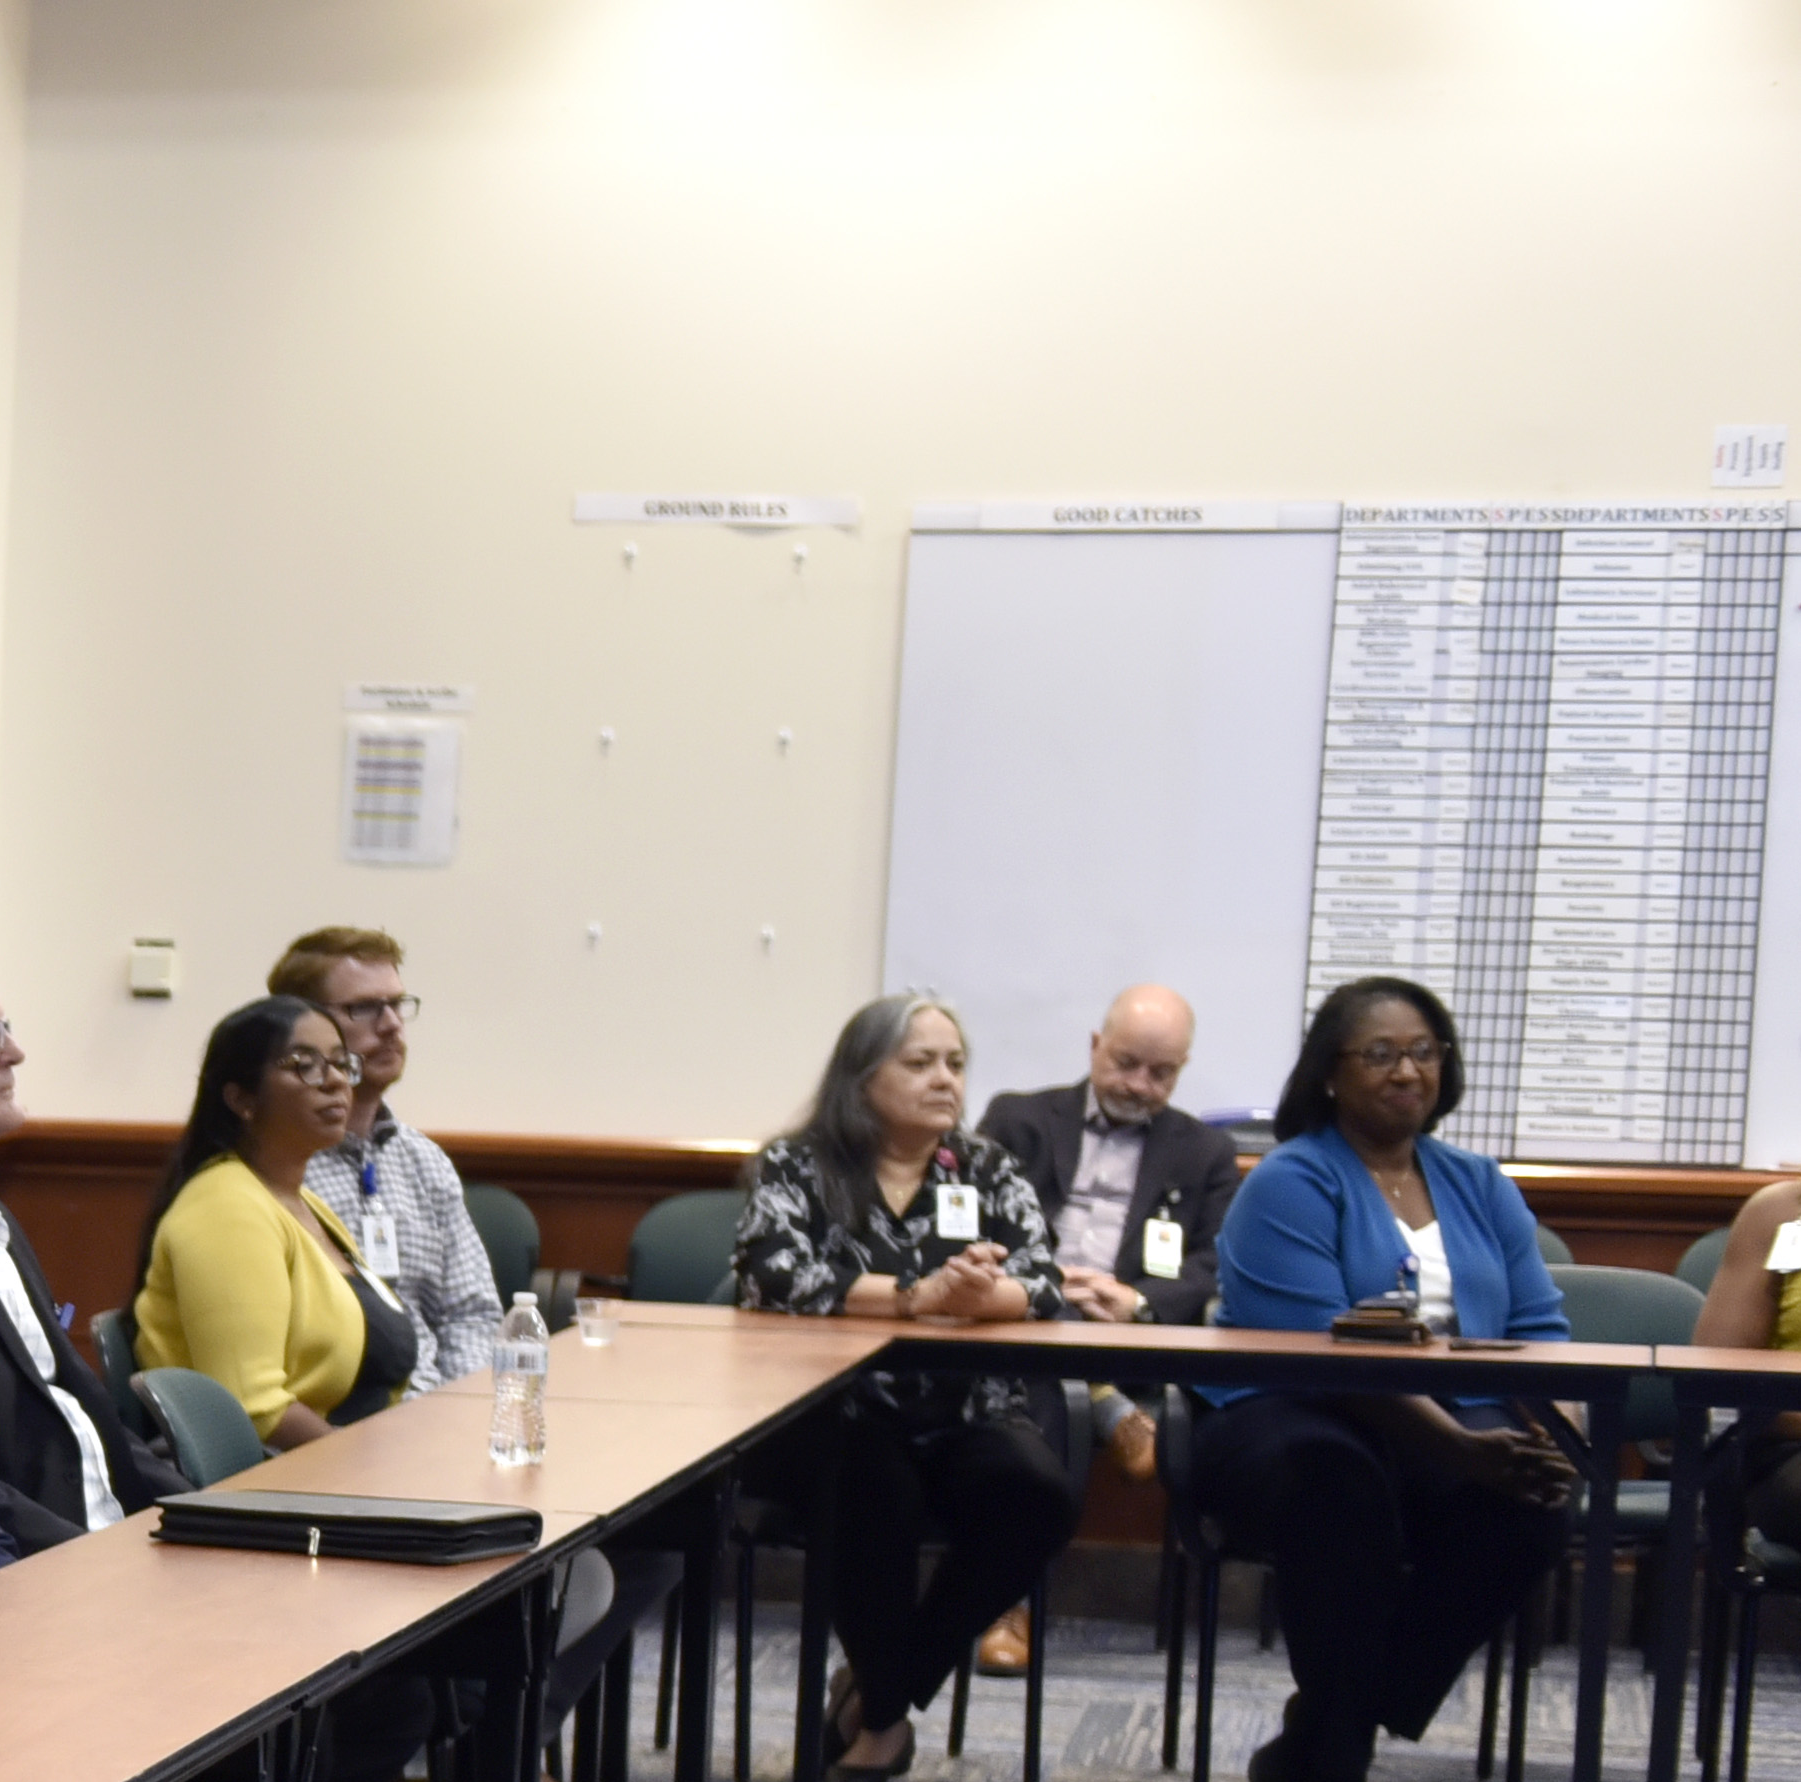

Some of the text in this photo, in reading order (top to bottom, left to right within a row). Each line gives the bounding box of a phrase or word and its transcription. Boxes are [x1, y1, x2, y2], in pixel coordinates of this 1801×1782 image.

[644, 500, 789, 519] GROUND RULES
[1053, 505, 1203, 522] GOOD CATCHES
